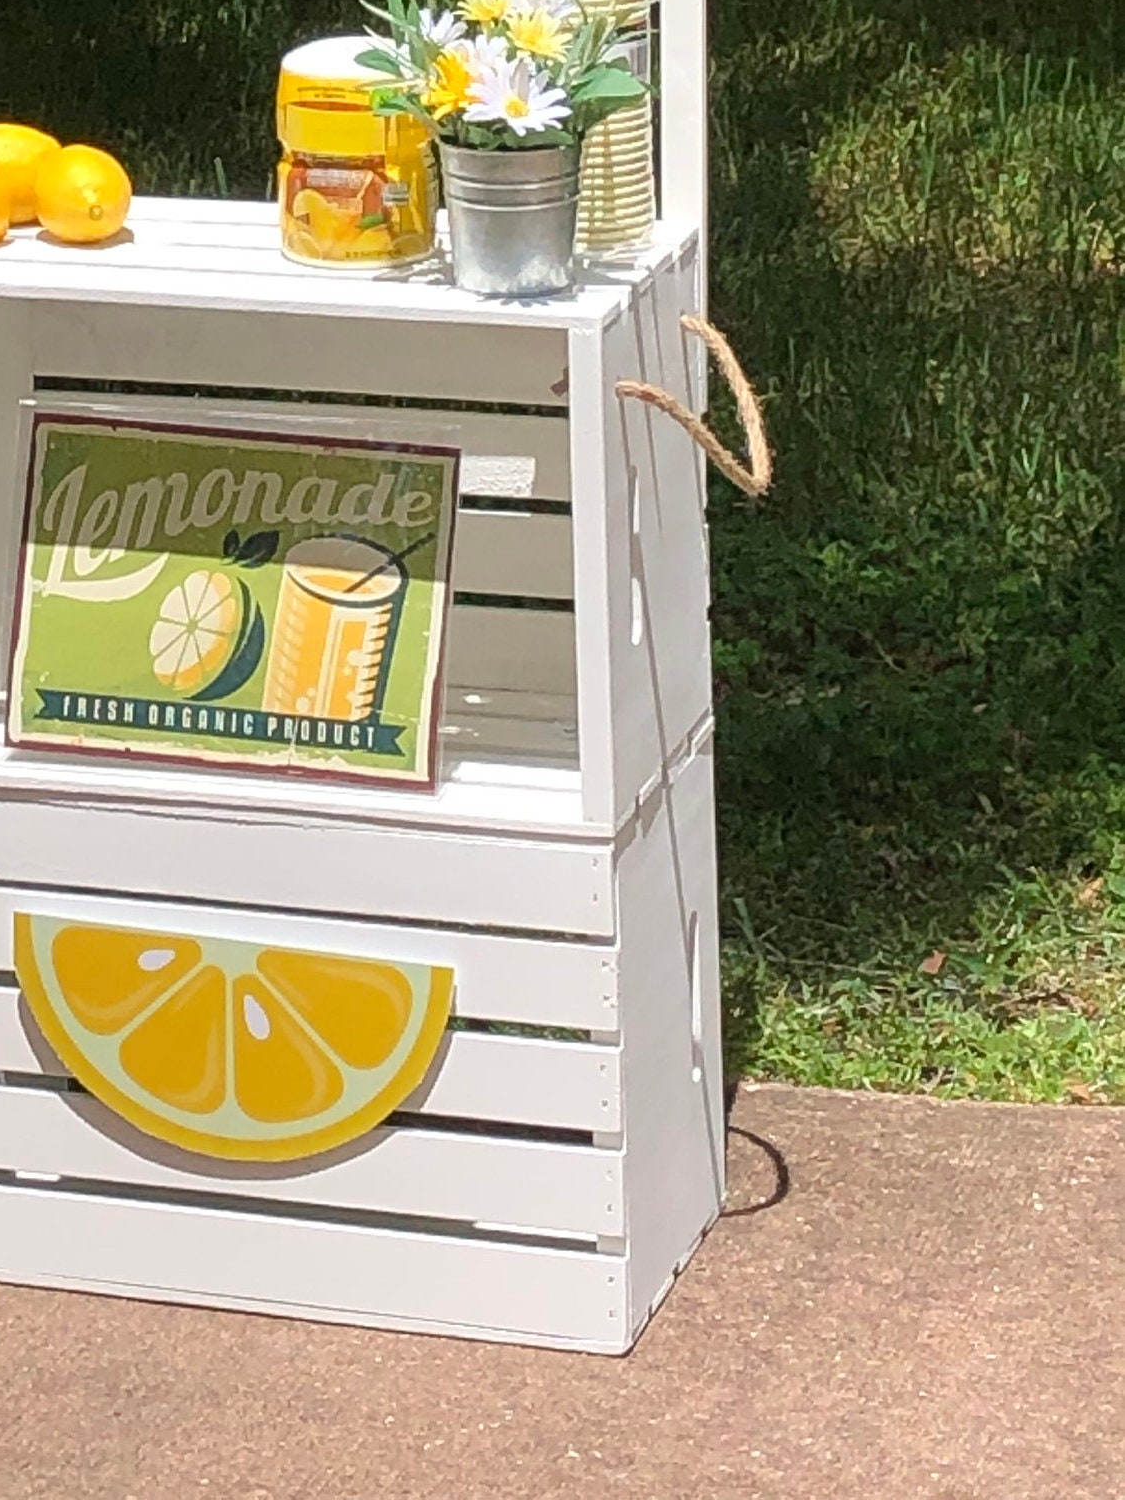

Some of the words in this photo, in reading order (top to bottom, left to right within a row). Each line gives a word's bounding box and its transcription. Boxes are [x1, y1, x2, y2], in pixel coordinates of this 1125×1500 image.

[42, 463, 434, 602] Lemonade
[62, 694, 136, 723] FRESH
[147, 703, 255, 737] ORGANIC
[266, 716, 377, 749] PRODUCT
